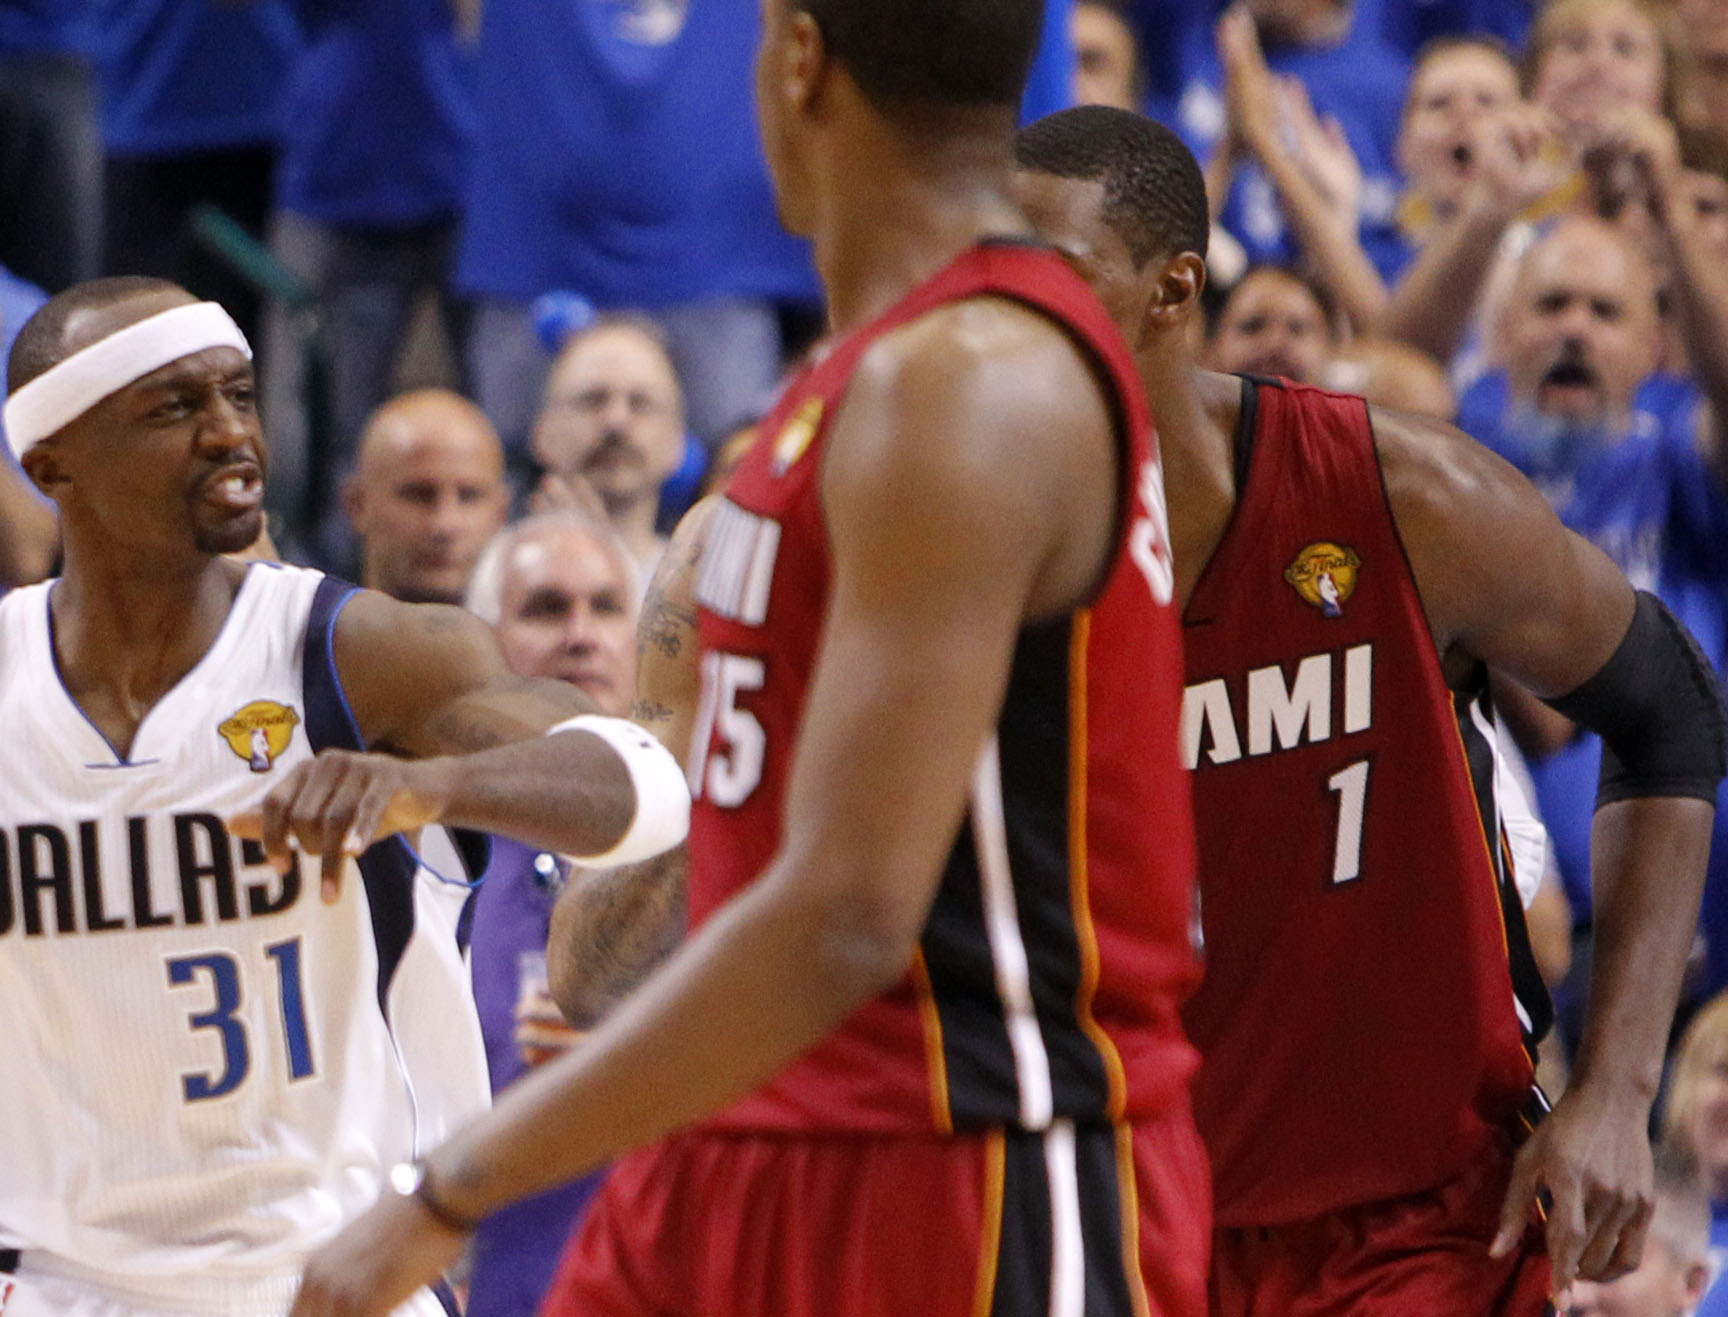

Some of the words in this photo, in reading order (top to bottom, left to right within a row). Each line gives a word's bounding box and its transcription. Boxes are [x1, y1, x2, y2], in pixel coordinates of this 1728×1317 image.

[689, 649, 766, 809] 15
[1328, 760, 1370, 884] 1
[165, 935, 315, 1105] 31
